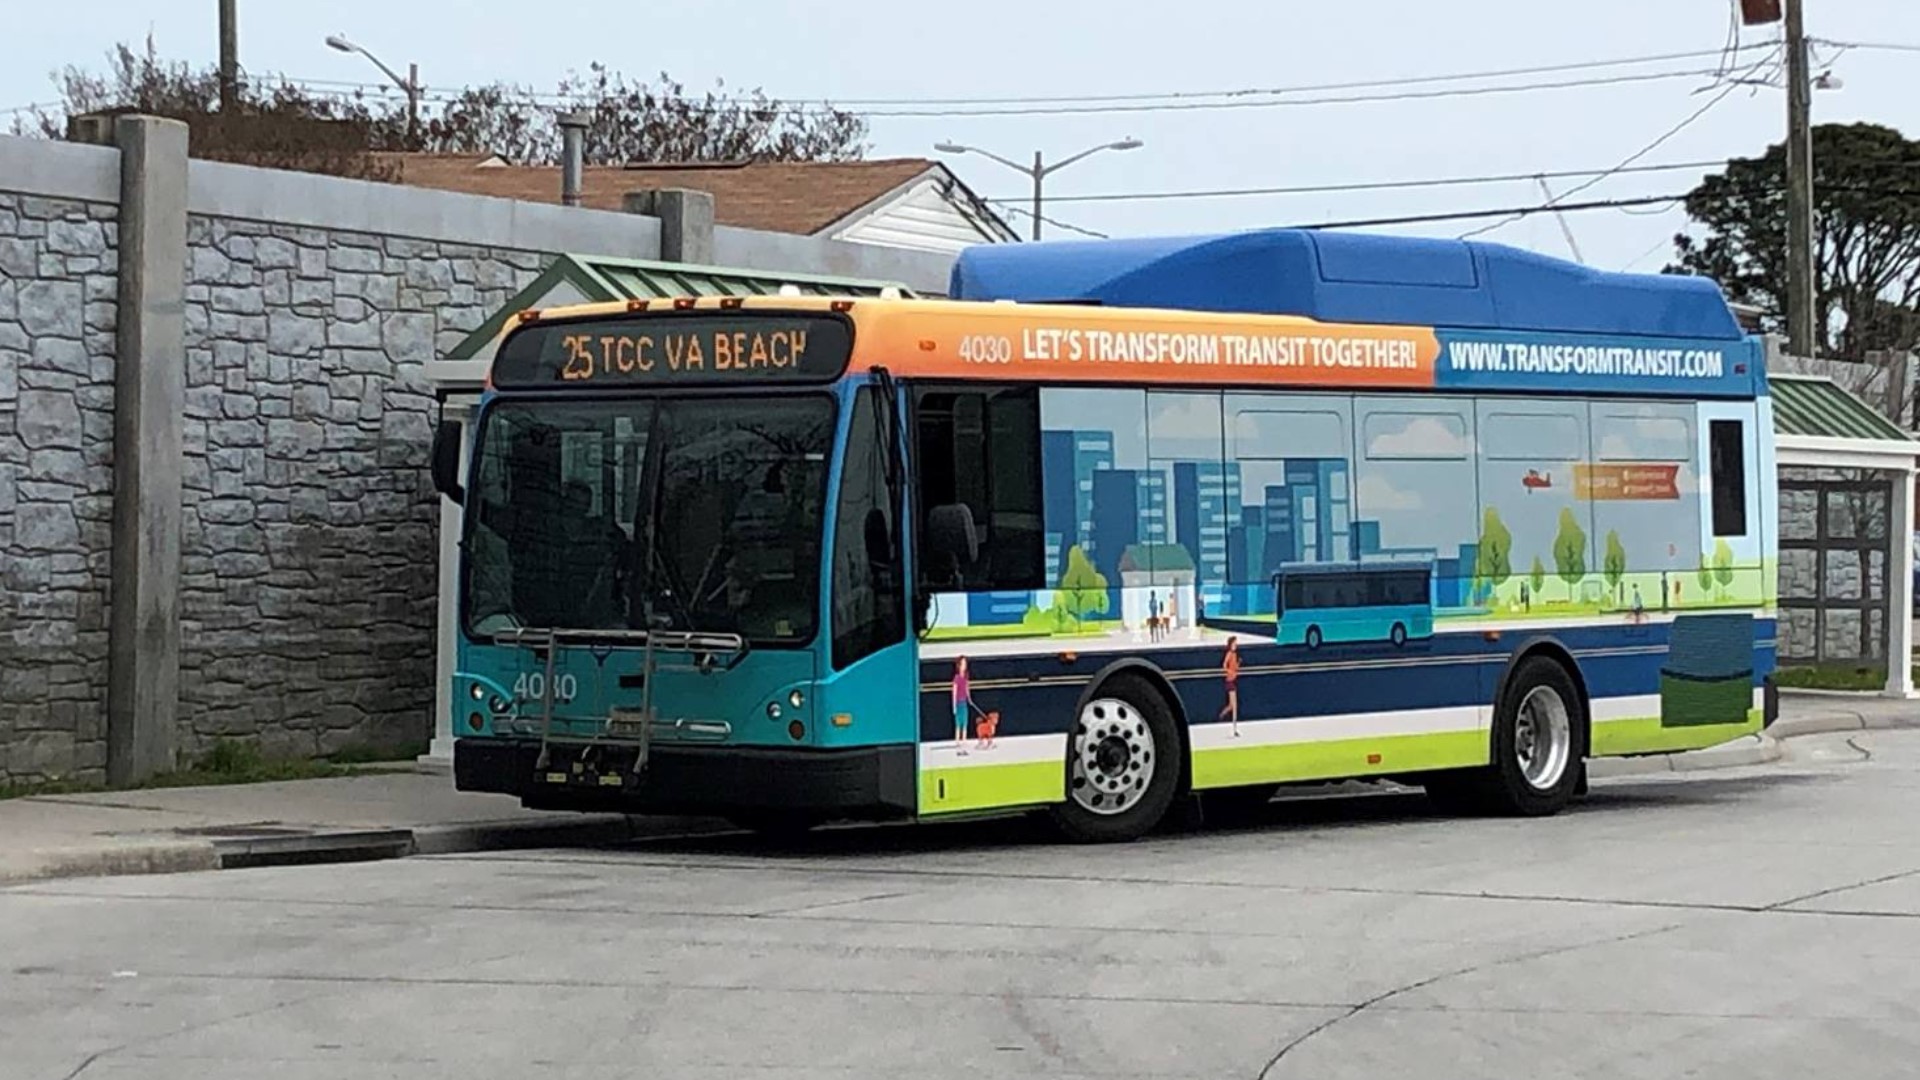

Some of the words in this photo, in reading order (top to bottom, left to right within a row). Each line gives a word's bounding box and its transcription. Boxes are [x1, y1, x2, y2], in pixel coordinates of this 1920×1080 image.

[561, 334, 594, 380] 25
[600, 335, 655, 374] TCC
[664, 333, 704, 371] VA
[713, 329, 807, 370] BEACH
[959, 334, 1012, 365] 4030
[1022, 327, 1083, 362] LET'S
[1084, 329, 1219, 366] TRANSFORM
[1221, 334, 1307, 368] TRANSIT
[1309, 335, 1418, 369] TOGETHER!
[1448, 340, 1724, 378] WWW.TRANSFORMTRANSIT.COM
